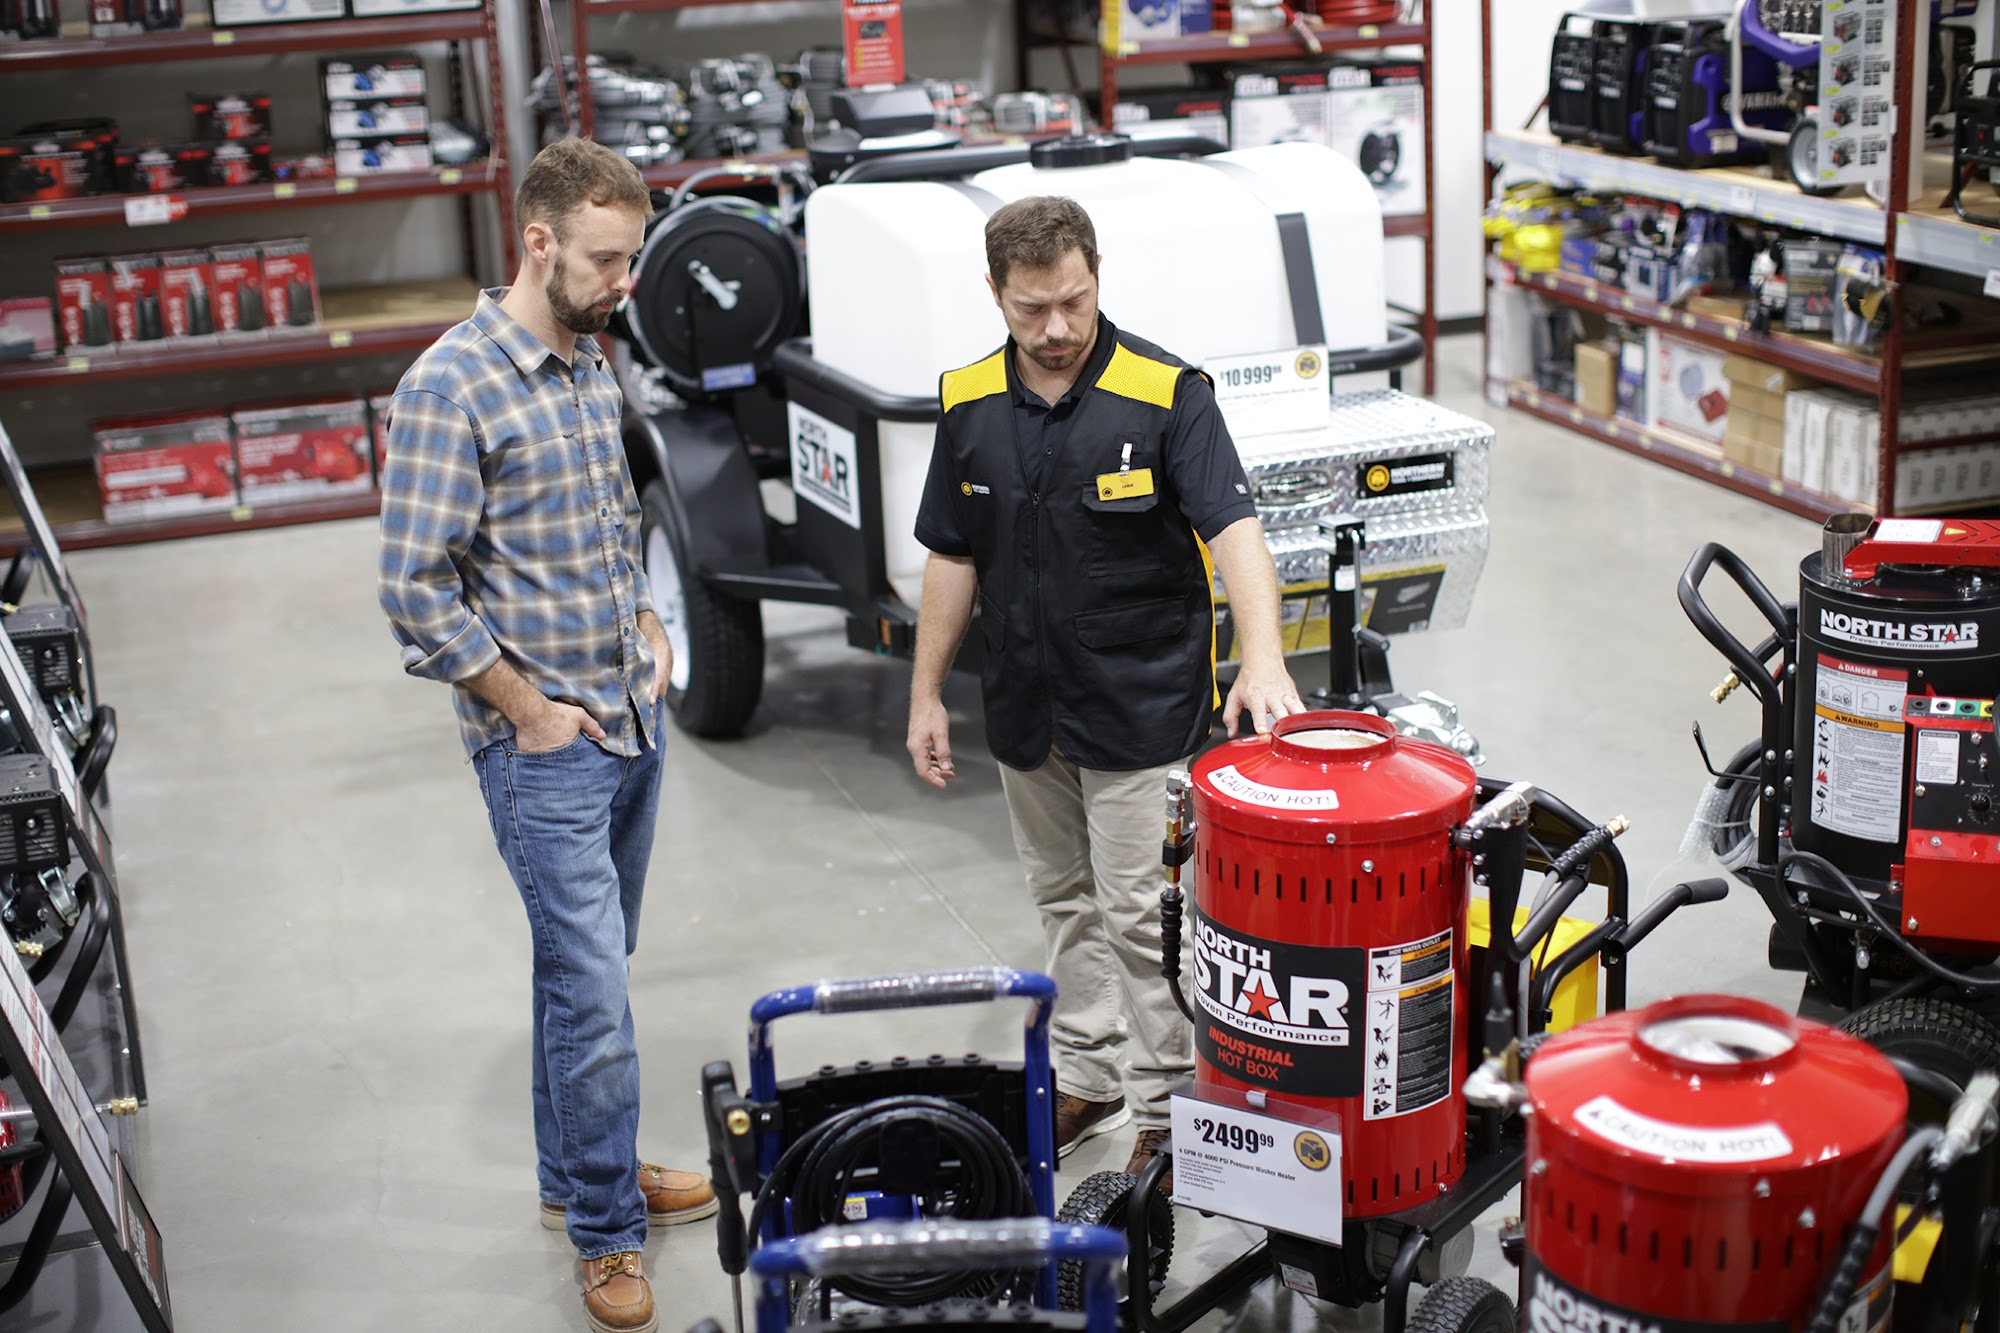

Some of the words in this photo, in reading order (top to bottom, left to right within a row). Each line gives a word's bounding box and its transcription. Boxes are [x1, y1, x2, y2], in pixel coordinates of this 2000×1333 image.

[798, 434, 849, 499] STAR
[1820, 608, 1906, 640] NORTH
[1909, 622, 1980, 642] STAR
[1850, 635, 1878, 646] Proven
[1880, 640, 1940, 649] Performance
[1844, 663, 1878, 678] DANGER
[1841, 715, 1879, 729] WARNING
[1221, 773, 1280, 803] CAUTION
[1287, 795, 1331, 805] HOT!
[1196, 914, 1271, 971] NORTH
[1194, 934, 1349, 1028] STAR
[1226, 1012, 1342, 1043] Performance
[1208, 1025, 1295, 1068] INDUSTRIAL
[1217, 1046, 1244, 1071] HOT
[1245, 1059, 1280, 1082] BOX
[1203, 1153, 1219, 1162] 4000
[1219, 1157, 1229, 1165] PSI
[1229, 1159, 1255, 1172] Pressure
[1255, 1165, 1277, 1177] Washer
[1277, 1171, 1296, 1181] Heater
